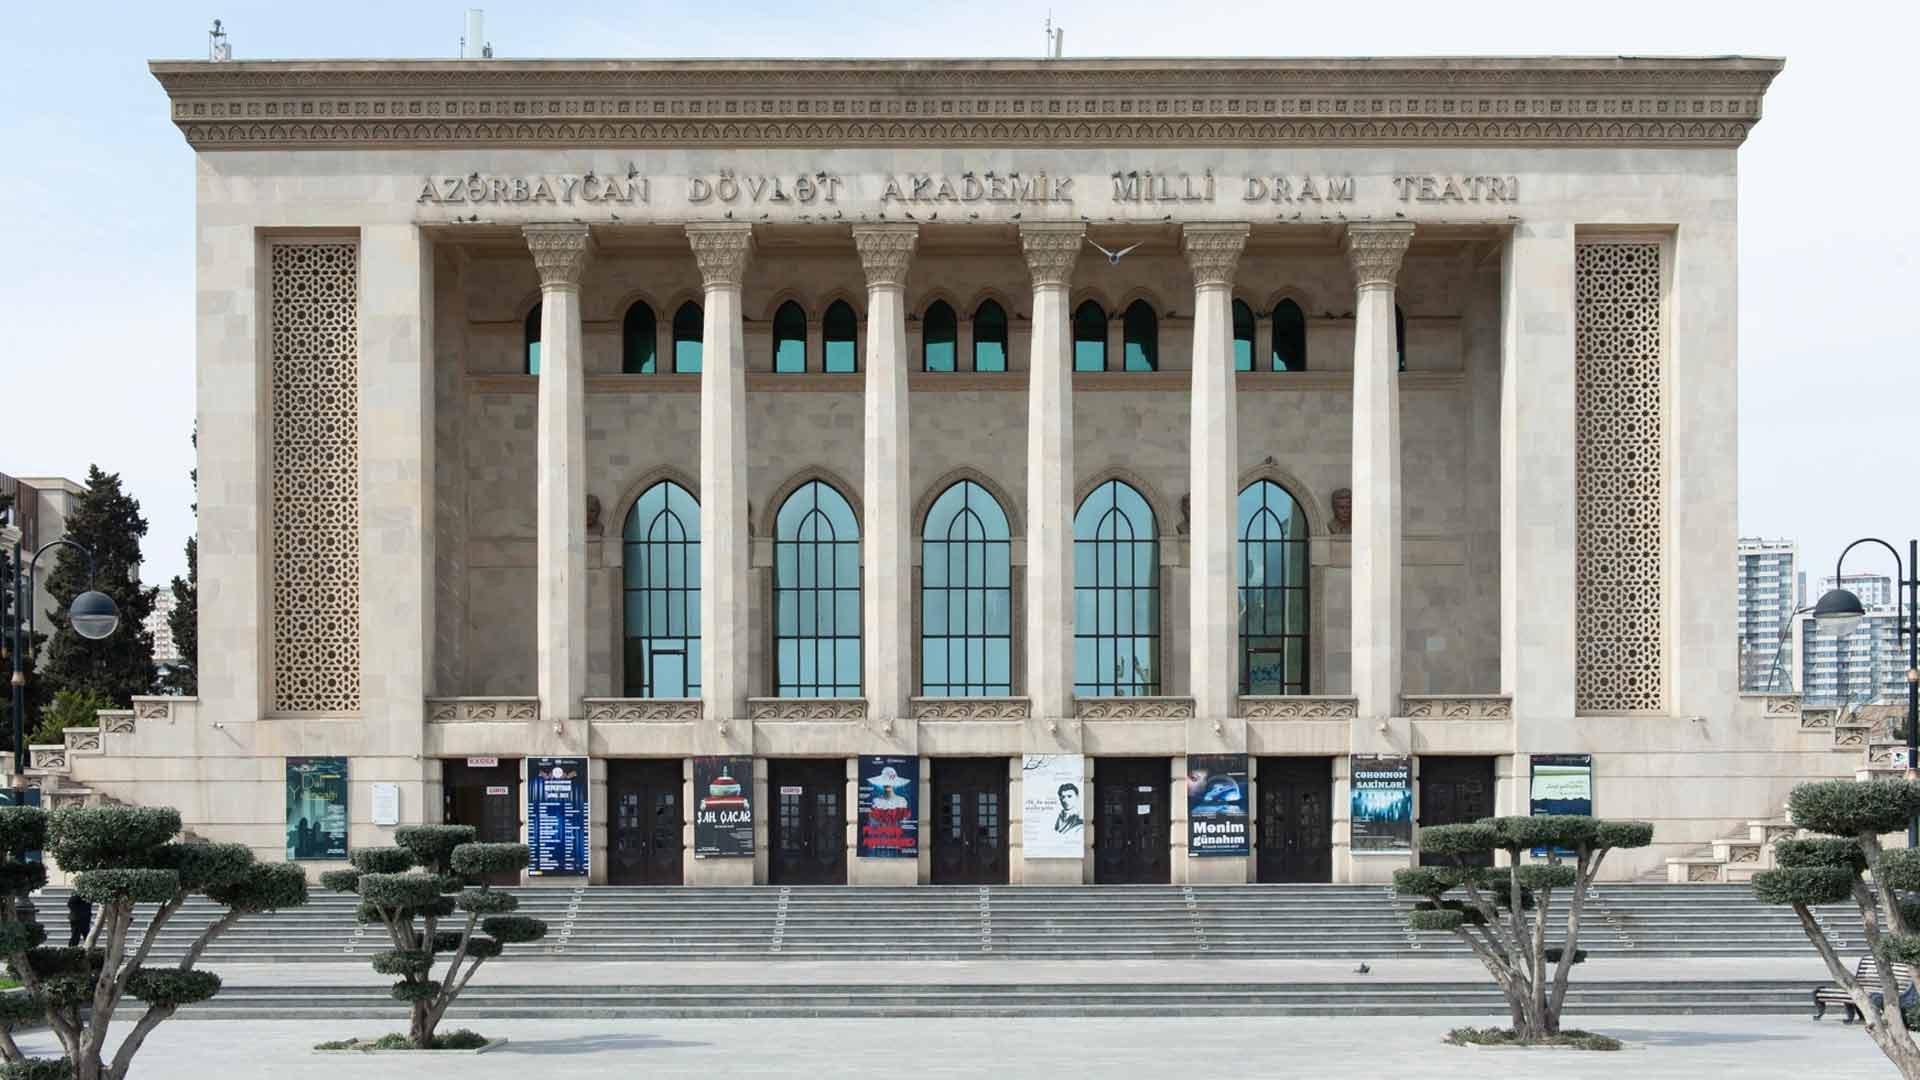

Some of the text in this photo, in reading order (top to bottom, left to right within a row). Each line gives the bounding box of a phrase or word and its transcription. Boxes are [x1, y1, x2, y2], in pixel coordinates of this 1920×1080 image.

[416, 168, 1520, 205] AZƏRBAYCAN DÖVLƏT AKADEMİK MİLLİ DRAM TEATRI
[1193, 821, 1244, 834] Mənim
[1193, 834, 1245, 847] günahım
